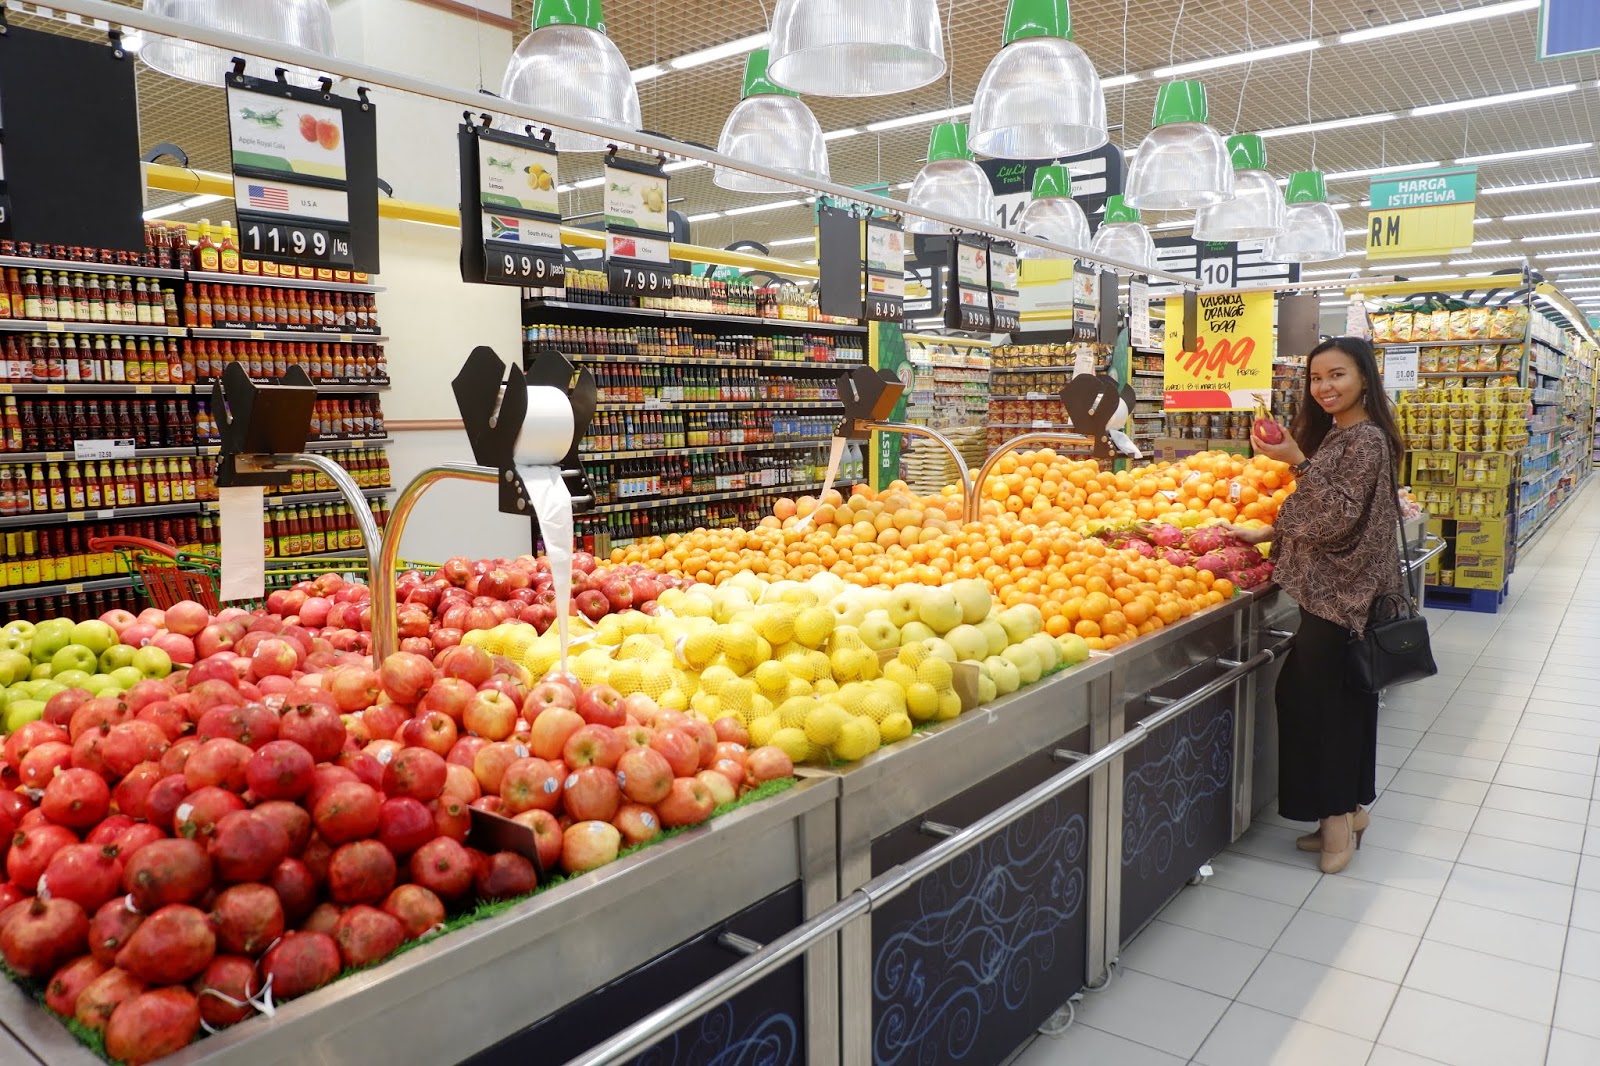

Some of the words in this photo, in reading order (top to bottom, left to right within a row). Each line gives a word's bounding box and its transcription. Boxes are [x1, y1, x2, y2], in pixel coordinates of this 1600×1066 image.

[238, 136, 256, 146] Apple
[257, 139, 272, 148] Royal
[273, 142, 286, 150] Gala
[488, 182, 504, 190] Lemon
[1003, 176, 1021, 184] Fresh
[1398, 178, 1447, 193] HARGA
[1388, 190, 1456, 206] ISTIMEWA
[527, 229, 540, 237] South
[1371, 215, 1400, 247] RM
[248, 225, 327, 256] 11.99
[333, 238, 348, 256] /kg
[504, 254, 546, 278] 9.99
[550, 262, 565, 277] /pack
[1204, 263, 1229, 284] 10
[623, 269, 657, 290] 7.99
[662, 276, 672, 289] /kg
[1200, 294, 1245, 308] VALENCIA
[1204, 305, 1245, 321] ORANGE
[882, 431, 890, 468] BEST
